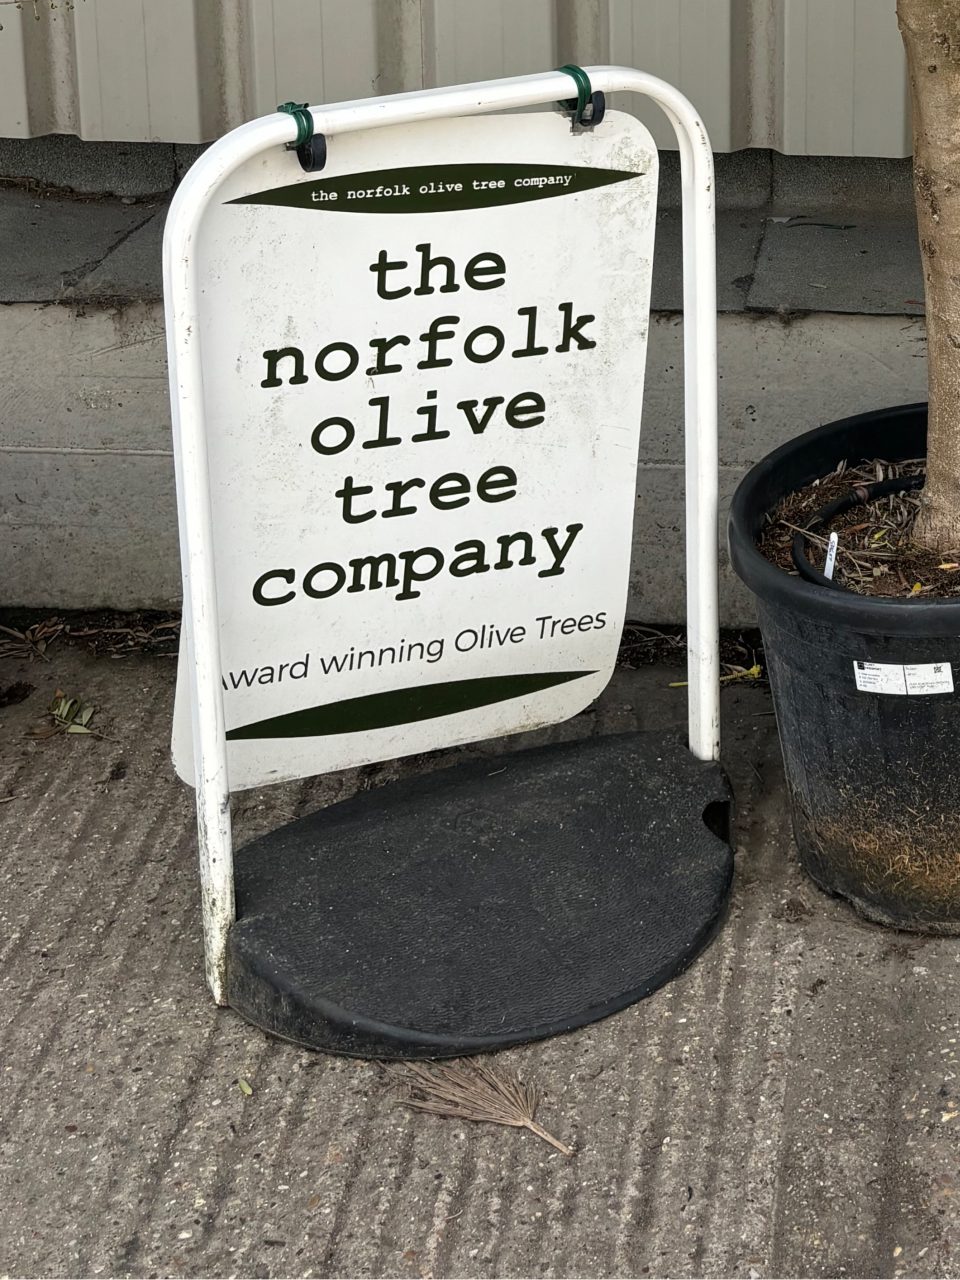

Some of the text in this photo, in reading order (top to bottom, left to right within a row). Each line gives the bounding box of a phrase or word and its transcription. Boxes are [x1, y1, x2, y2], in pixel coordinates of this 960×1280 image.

[311, 174, 573, 202] the norfolk olive tree company
[369, 242, 506, 301] the
[260, 301, 597, 389] norfolk
[310, 389, 546, 456] olive
[334, 465, 518, 525] tree
[252, 523, 584, 607] company
[319, 638, 445, 675] winning
[454, 623, 526, 653] Olive
[535, 610, 607, 640] Trees
